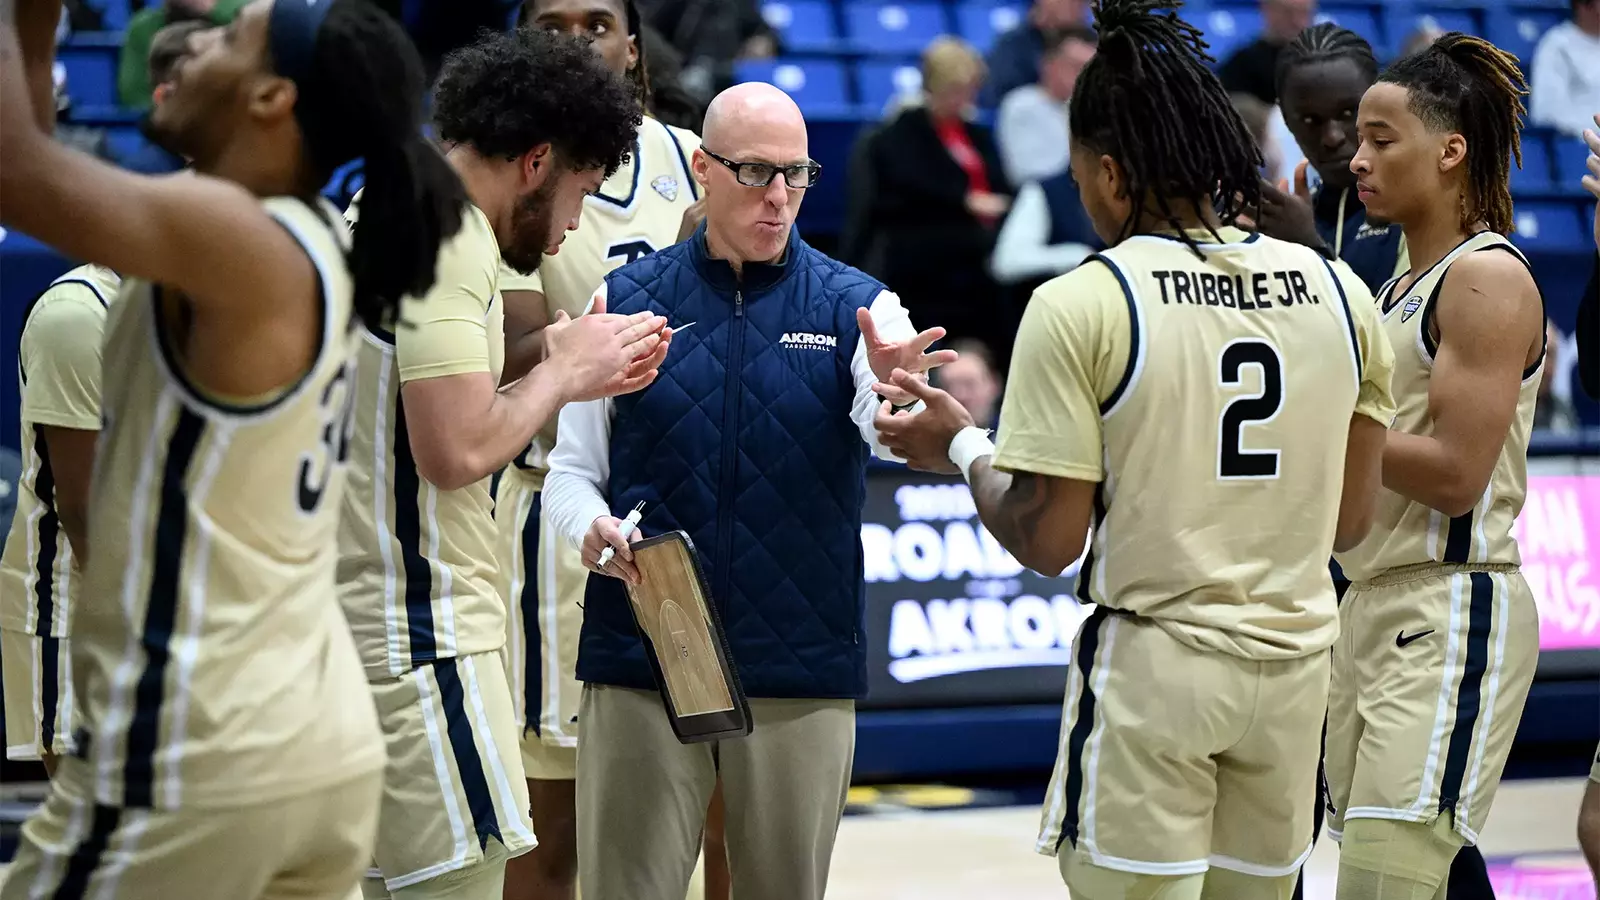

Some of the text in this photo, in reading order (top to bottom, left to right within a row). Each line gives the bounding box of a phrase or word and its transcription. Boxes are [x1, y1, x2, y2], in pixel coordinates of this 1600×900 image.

[1152, 270, 1320, 310] TRIBBLE JR.
[779, 332, 837, 347] AKRON
[784, 343, 831, 351] BASKETBALL
[1218, 338, 1284, 479] 2
[888, 594, 1098, 658] AKRON
